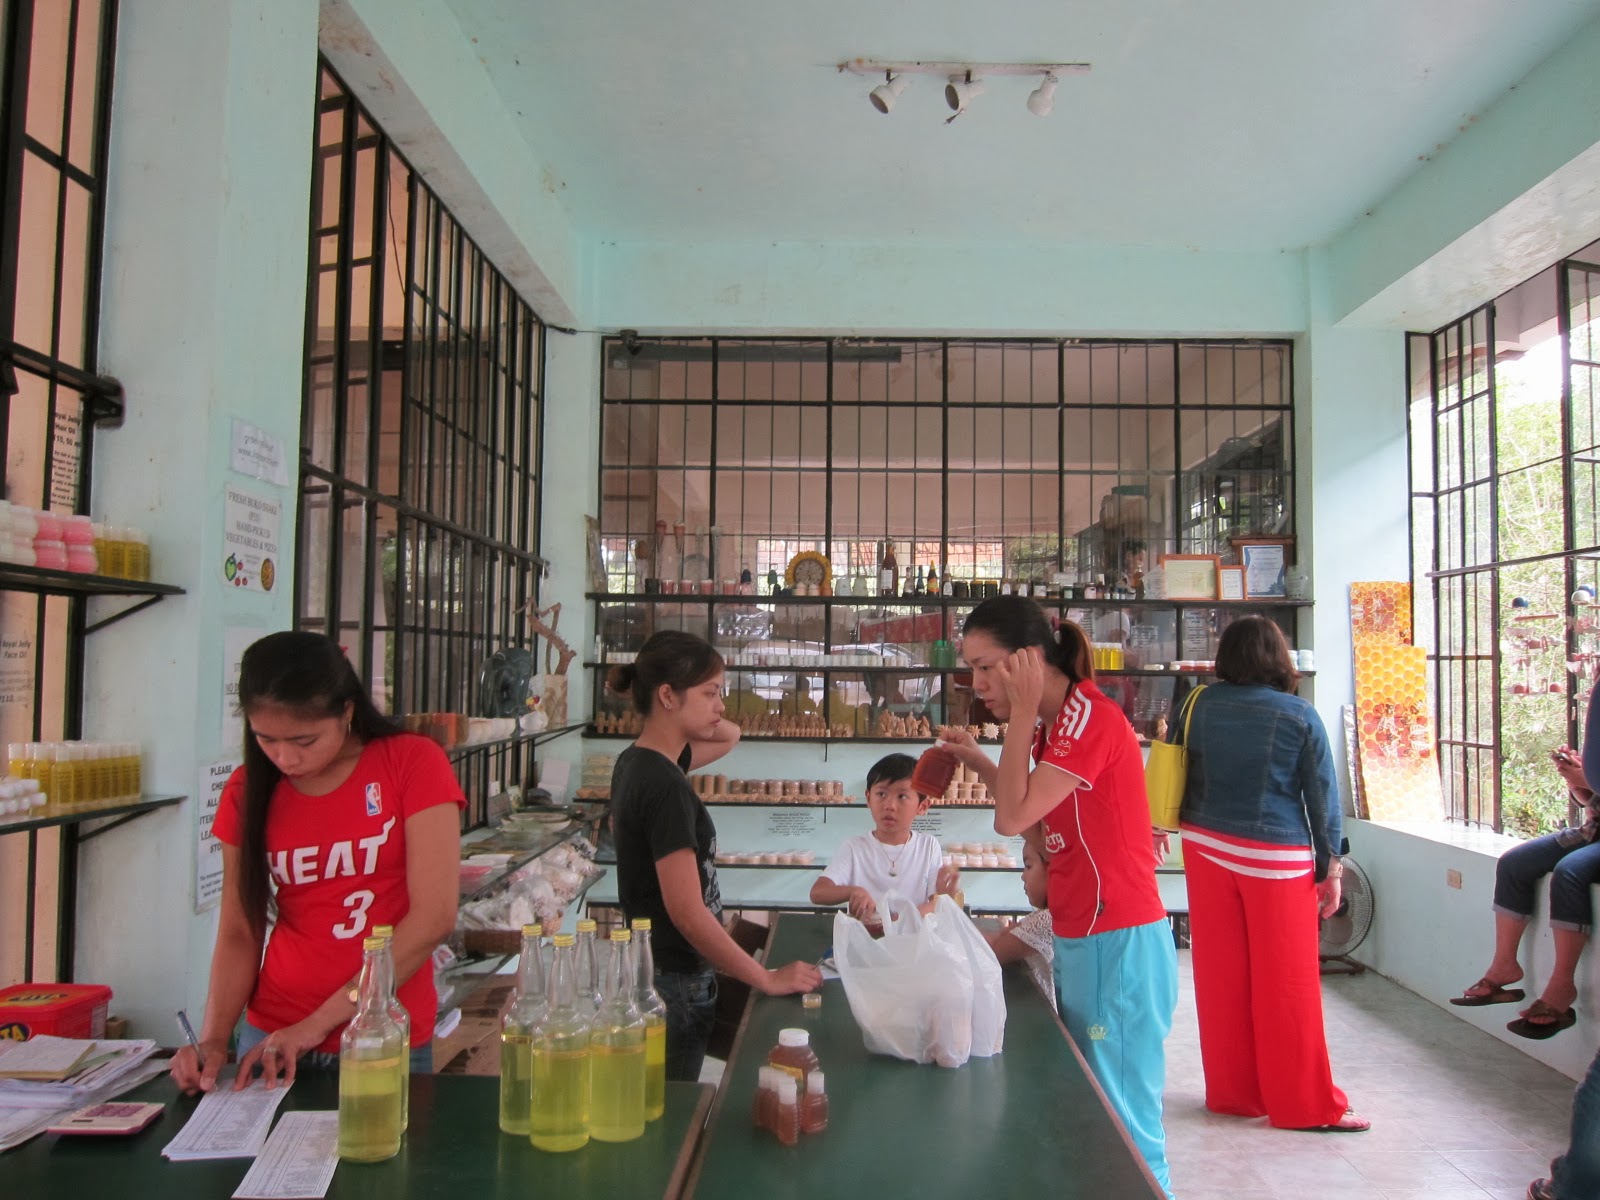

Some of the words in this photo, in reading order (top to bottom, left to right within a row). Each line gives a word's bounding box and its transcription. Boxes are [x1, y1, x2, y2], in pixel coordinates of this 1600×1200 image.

[228, 490, 247, 505] FRESH
[225, 531, 258, 549] VEGETABLES
[210, 764, 233, 776] PLEASE
[206, 797, 218, 808] ALL
[267, 815, 397, 886] HEAT
[332, 889, 376, 940] 3
